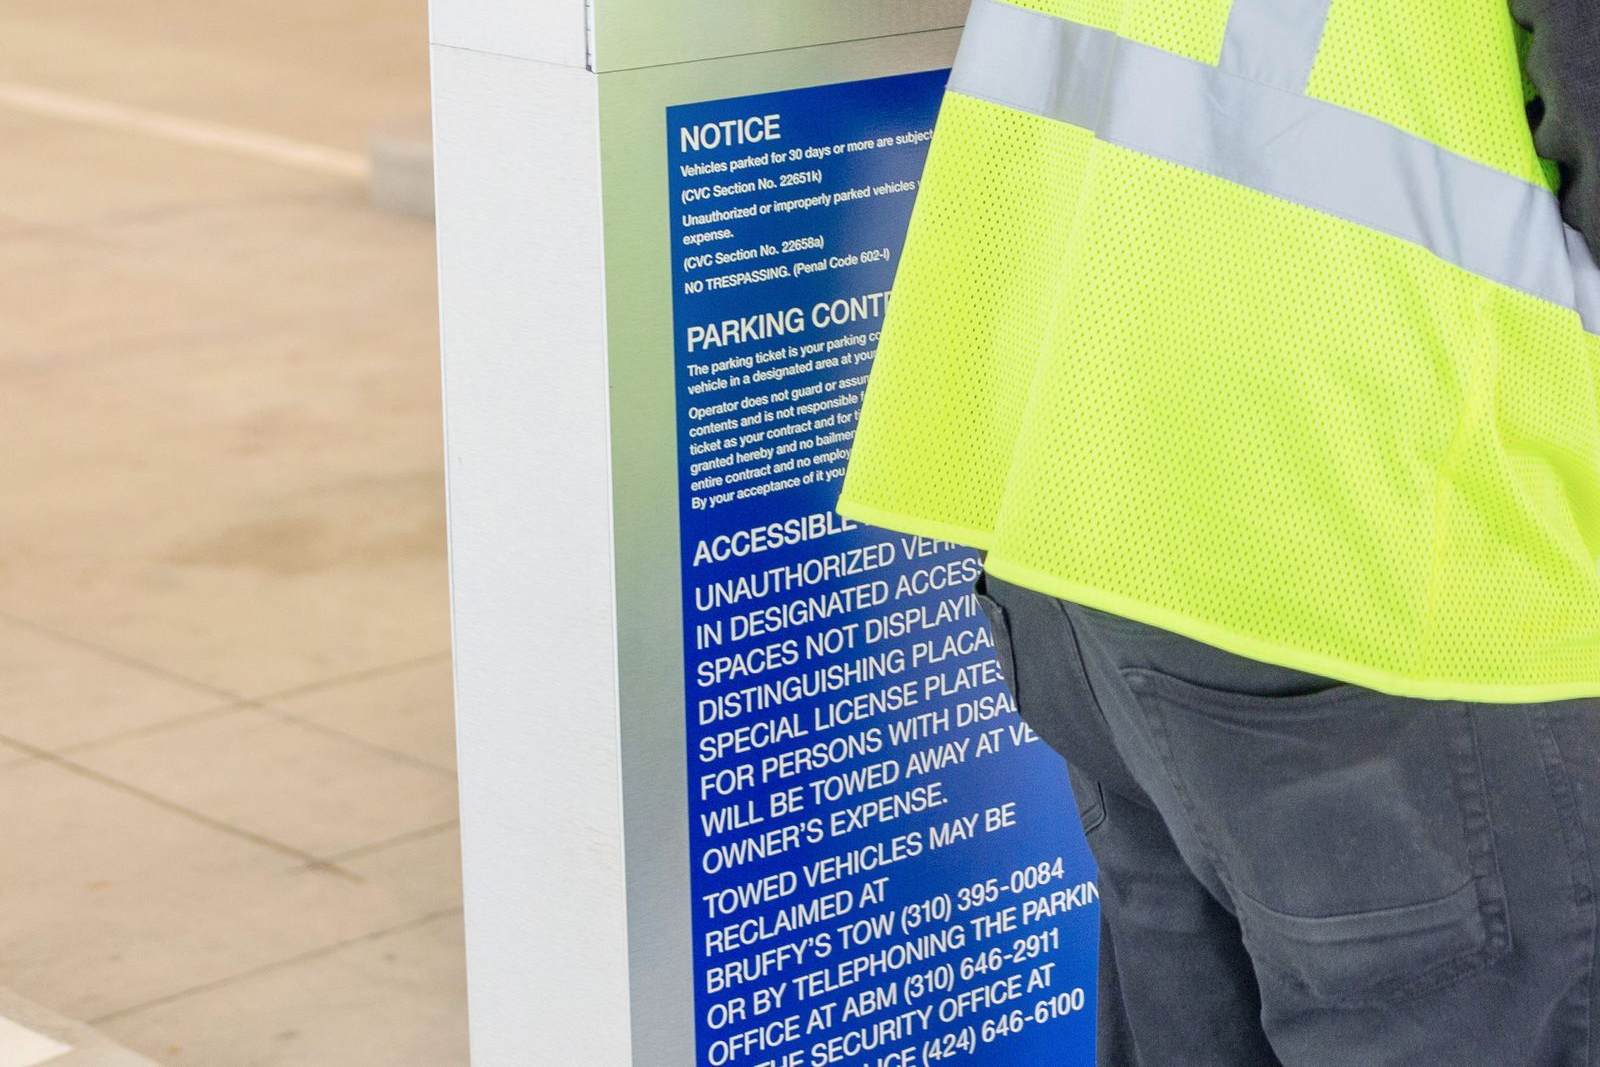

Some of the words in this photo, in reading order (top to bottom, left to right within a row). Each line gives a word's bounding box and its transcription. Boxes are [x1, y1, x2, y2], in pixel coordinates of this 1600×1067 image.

[680, 114, 780, 151] NOTICE
[679, 161, 728, 177] Vehicles
[729, 153, 769, 172] parked
[770, 151, 787, 163] for
[788, 148, 803, 161] 30
[804, 146, 831, 159] days
[846, 139, 875, 152] more
[876, 137, 894, 148] are
[681, 186, 710, 204] (CVC
[712, 182, 756, 197] Section
[757, 177, 777, 190] No.
[779, 170, 822, 186] 22651k)
[682, 204, 757, 226] Unauthorized
[758, 204, 772, 214] or
[773, 193, 832, 212] improperly
[833, 186, 870, 204] parked
[872, 180, 916, 195] vehicles
[682, 229, 734, 245] expense.
[683, 254, 713, 272] (CVC
[714, 248, 758, 264] Section
[759, 244, 779, 256] No.
[781, 235, 824, 253] 22658a)
[684, 280, 703, 294] NO
[705, 265, 791, 289] TRESPASSING.
[793, 258, 827, 277] (Penal
[828, 254, 858, 268] Code
[687, 308, 804, 351] PARKING
[686, 364, 709, 376] The
[711, 356, 753, 374] parking
[754, 348, 786, 363] ticket
[799, 342, 825, 358] your
[826, 334, 867, 352] parking
[687, 378, 728, 394] vehicle
[752, 360, 813, 382] designated
[814, 357, 839, 370] area
[688, 401, 739, 420] Operator
[740, 395, 769, 409] does
[790, 382, 823, 401] guard
[688, 419, 738, 437] contents
[796, 394, 858, 414] responsible
[689, 439, 722, 455] ticket
[766, 420, 812, 439] contract
[836, 412, 852, 424] for
[690, 454, 734, 476] granted
[736, 447, 774, 463] hereby
[690, 476, 723, 491] entire
[724, 464, 772, 483] contract
[691, 496, 708, 510] By
[708, 491, 735, 508] your
[736, 477, 801, 499] acceptance
[695, 543, 895, 610] UNAUTHORIZED
[696, 620, 722, 649] IN
[730, 581, 888, 640] DESIGNATED
[697, 640, 799, 686] SPACES
[806, 623, 859, 659] NOT
[698, 650, 905, 724] DISTINGUISHING
[912, 627, 994, 667] PLACA
[699, 714, 808, 761] SPECIAL
[814, 681, 918, 730] LICENSE
[700, 764, 754, 800] FOR
[762, 728, 882, 782] PERSONS
[888, 708, 949, 745] WITH
[700, 801, 764, 836] WILL
[770, 786, 804, 817] BE
[808, 760, 900, 804] TOWED
[905, 738, 970, 777] AWAY
[975, 728, 1004, 757] AT
[830, 783, 948, 836] EXPENSE.
[702, 871, 797, 917] TOWED
[802, 832, 922, 886] VEHICLES
[929, 813, 979, 849] MAY
[985, 802, 1016, 832] BE
[705, 890, 853, 955] RECLAIMED
[858, 877, 889, 908] AT
[836, 911, 895, 949] TOW
[901, 894, 952, 934] (310)
[957, 858, 1064, 910] 395-0084
[706, 997, 746, 1029] OR
[753, 982, 786, 1015] BY
[792, 925, 965, 999] TELEPHONING
[970, 906, 1017, 940] THE
[708, 1015, 800, 1065] OFFICE
[806, 1002, 837, 1034] AT
[842, 982, 897, 1021] ABM
[903, 964, 954, 1004] (310)
[960, 928, 1058, 980] 646-2911
[811, 1006, 933, 1067] SECURITY
[938, 975, 1022, 1022] OFFICE
[1028, 963, 1056, 992] AT
[922, 1026, 976, 1067] (424)
[982, 988, 1085, 1043] 646-6100
